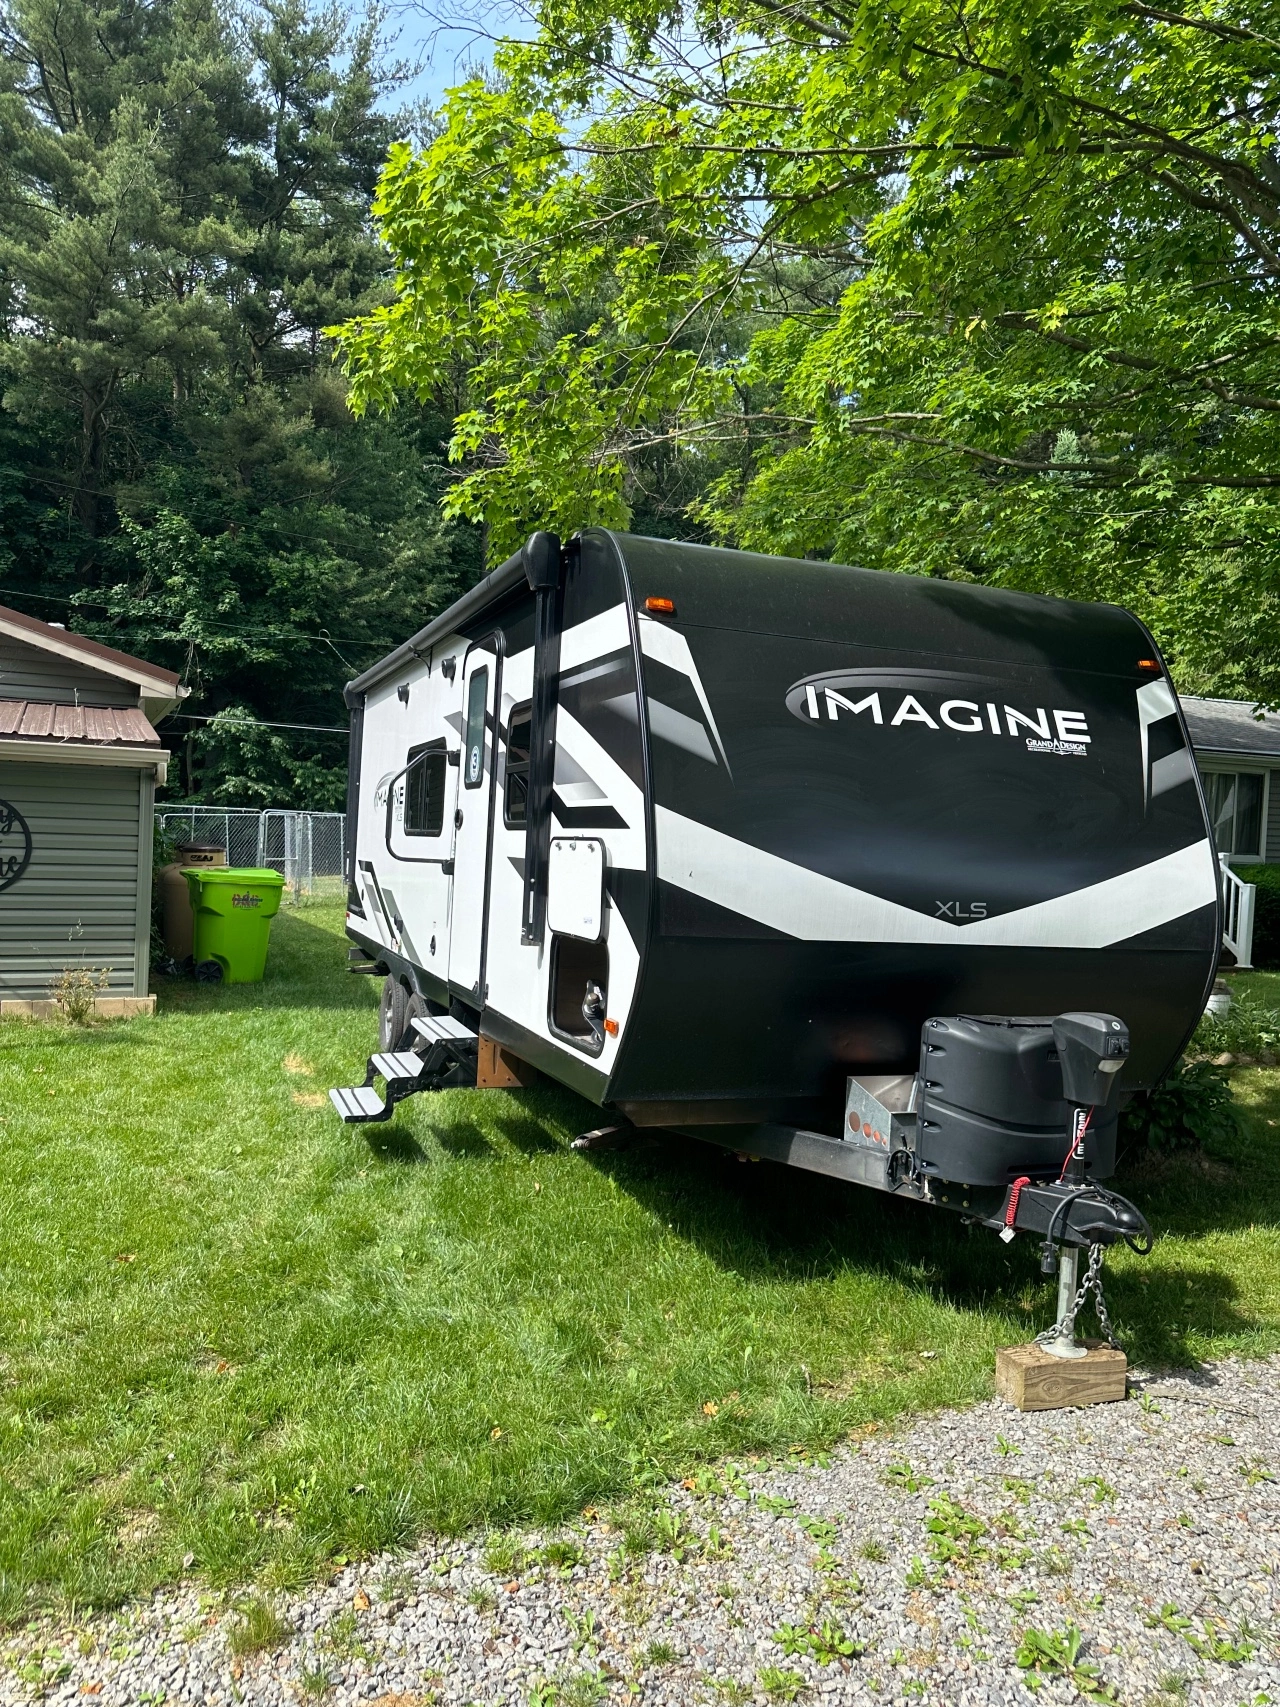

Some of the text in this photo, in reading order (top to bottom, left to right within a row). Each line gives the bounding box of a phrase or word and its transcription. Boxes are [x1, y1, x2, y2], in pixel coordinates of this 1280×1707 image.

[805, 685, 1092, 743] IMAGINE
[1025, 738, 1053, 747] GRAND
[1059, 741, 1087, 751] DESIGN
[934, 900, 987, 918] XLS
